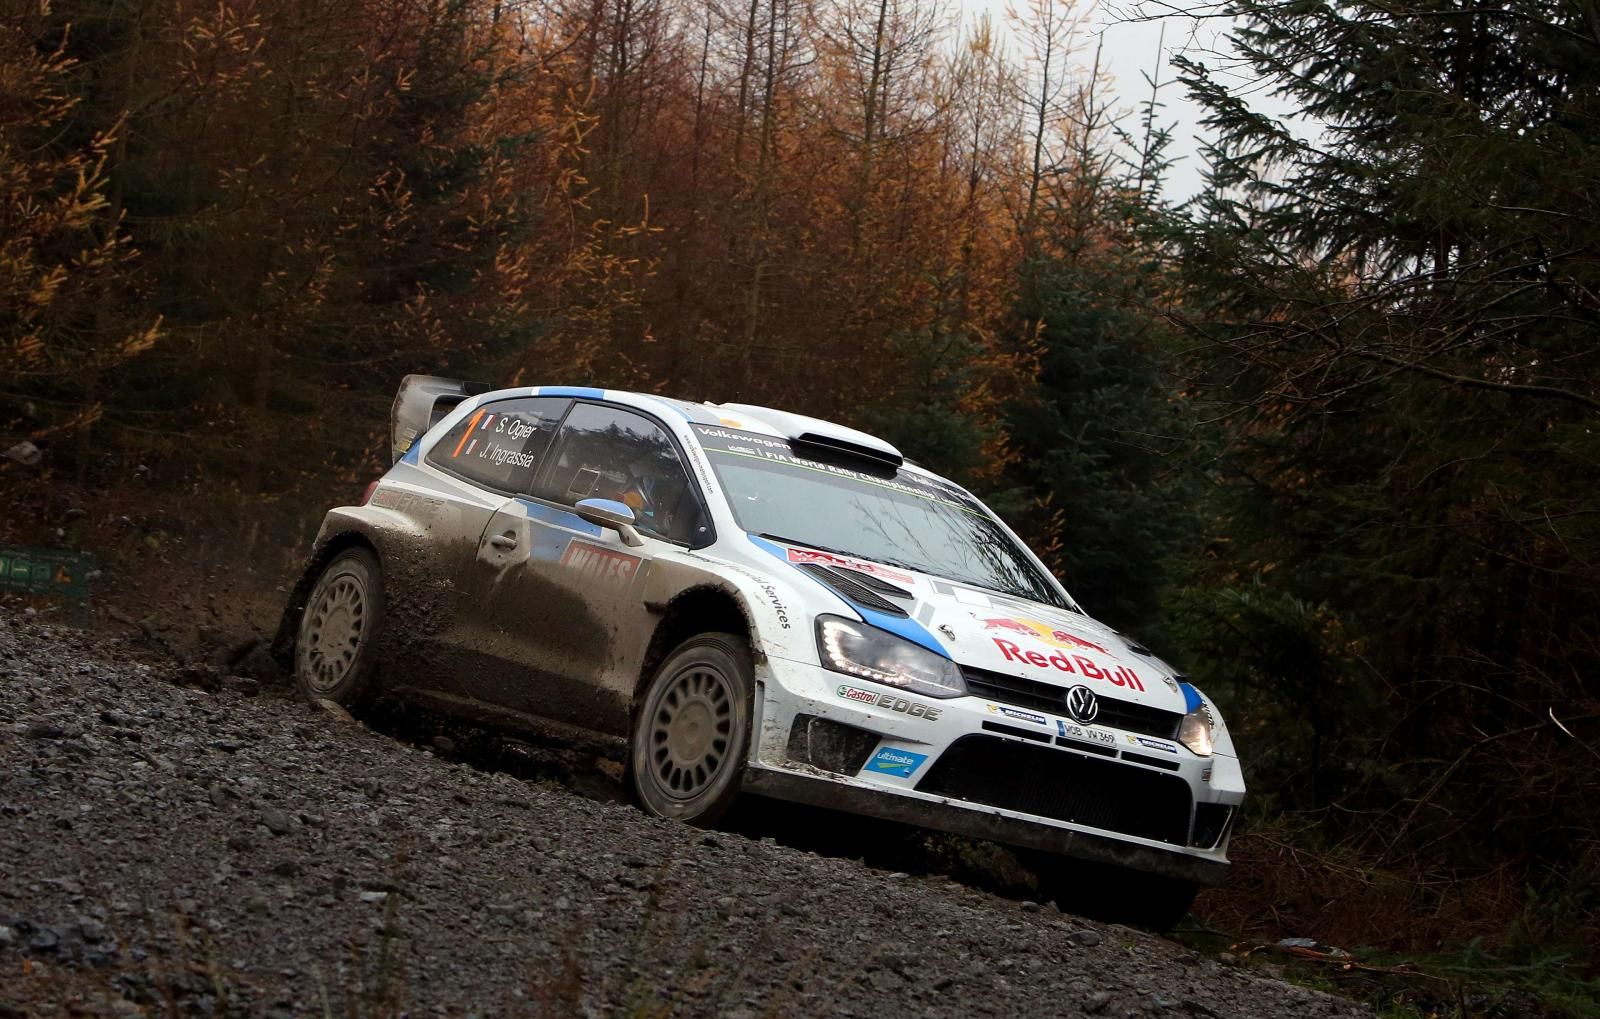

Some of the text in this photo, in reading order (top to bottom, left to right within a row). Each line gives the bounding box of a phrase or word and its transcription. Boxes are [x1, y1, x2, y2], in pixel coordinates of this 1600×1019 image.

[452, 408, 487, 458] 1
[495, 417, 537, 441] S. Ogier
[698, 426, 792, 450] Volkswagen
[479, 442, 535, 469] J. Ingrassia
[765, 451, 788, 463] FIA
[788, 456, 826, 471] World
[828, 465, 858, 479] Rally
[761, 584, 791, 630] Services
[992, 637, 1145, 692] Red Bull
[846, 687, 943, 722] Castrol EDGE
[1005, 708, 1045, 723] MICHELIN
[1099, 730, 1116, 744] 369
[1142, 739, 1176, 752] MICHELIN
[877, 752, 914, 766] ultimate
